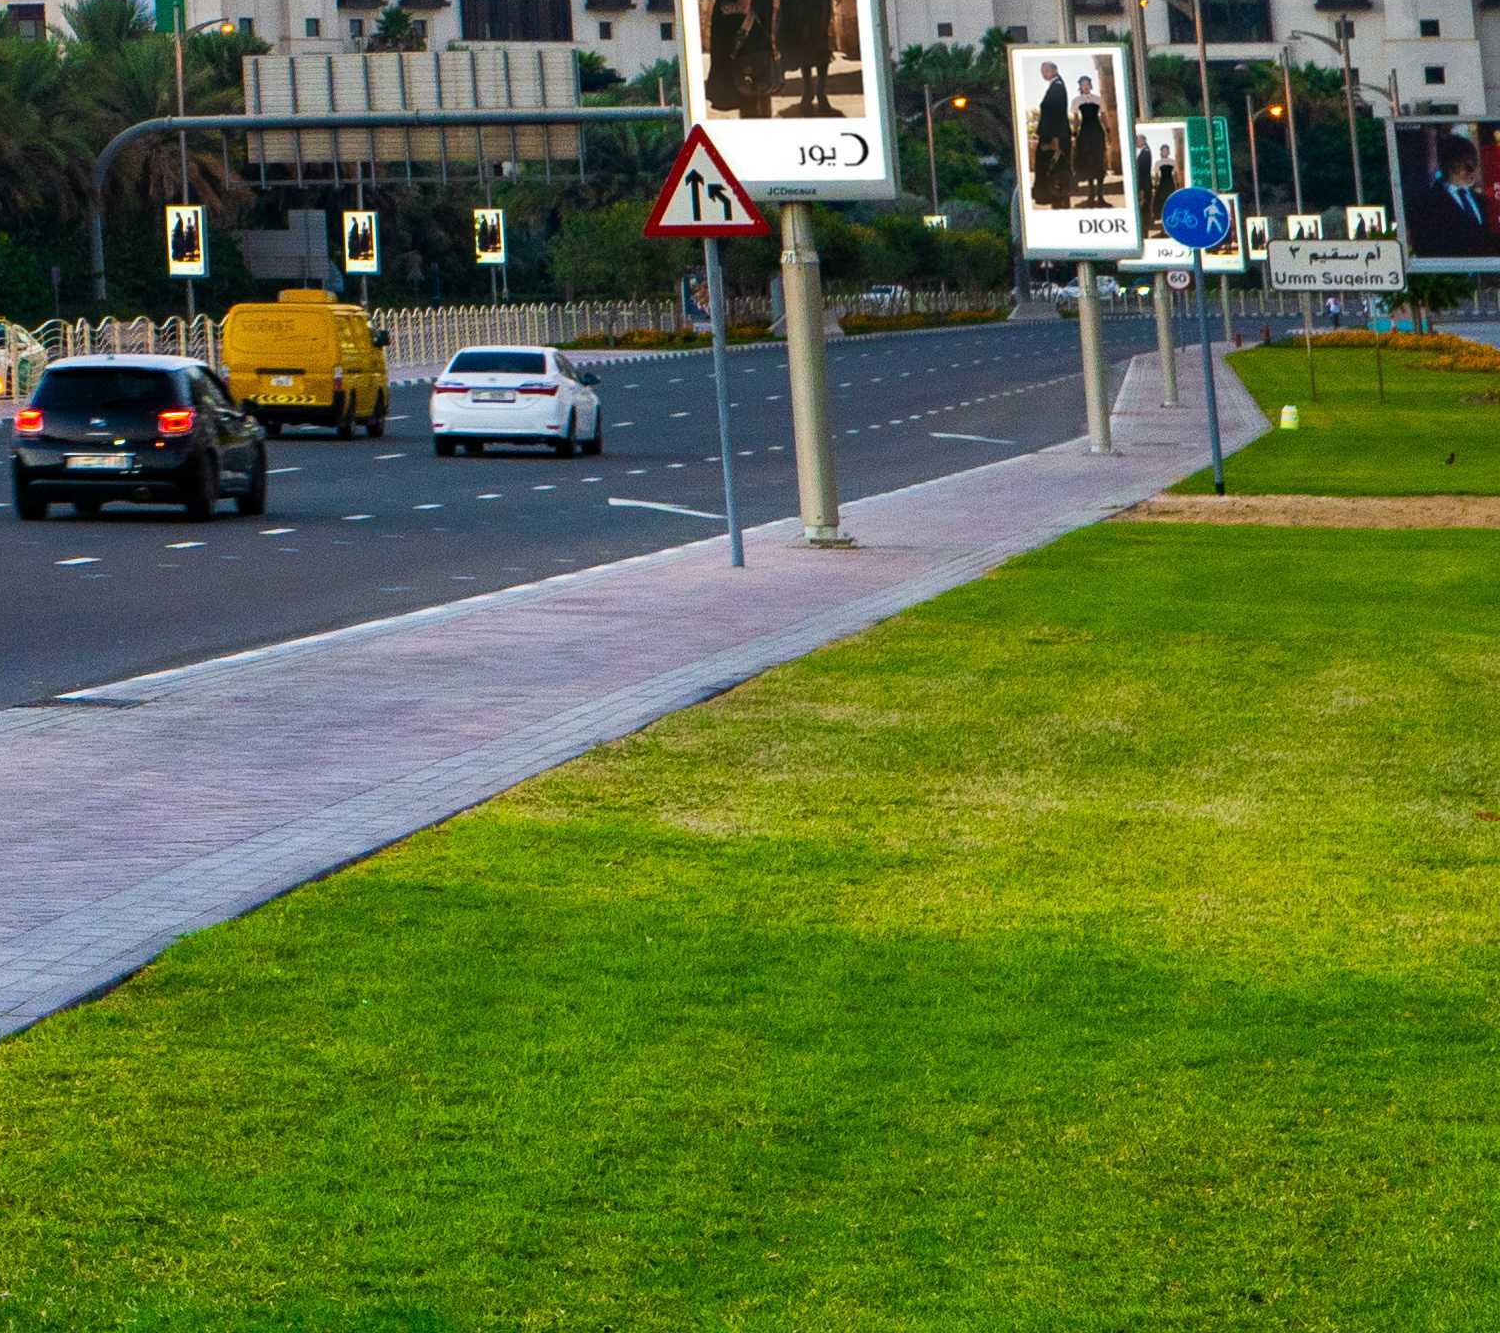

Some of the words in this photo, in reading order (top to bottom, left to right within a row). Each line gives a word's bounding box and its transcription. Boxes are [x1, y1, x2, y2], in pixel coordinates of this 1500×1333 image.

[798, 132, 869, 167] ديور
[1078, 217, 1129, 234] DIOR
[1308, 247, 1360, 267] سقيم
[1365, 243, 1382, 268] أم
[1169, 273, 1187, 284] 60
[1274, 271, 1317, 285] Umm
[1321, 271, 1384, 287] Suqeim
[1388, 271, 1401, 285] 3
